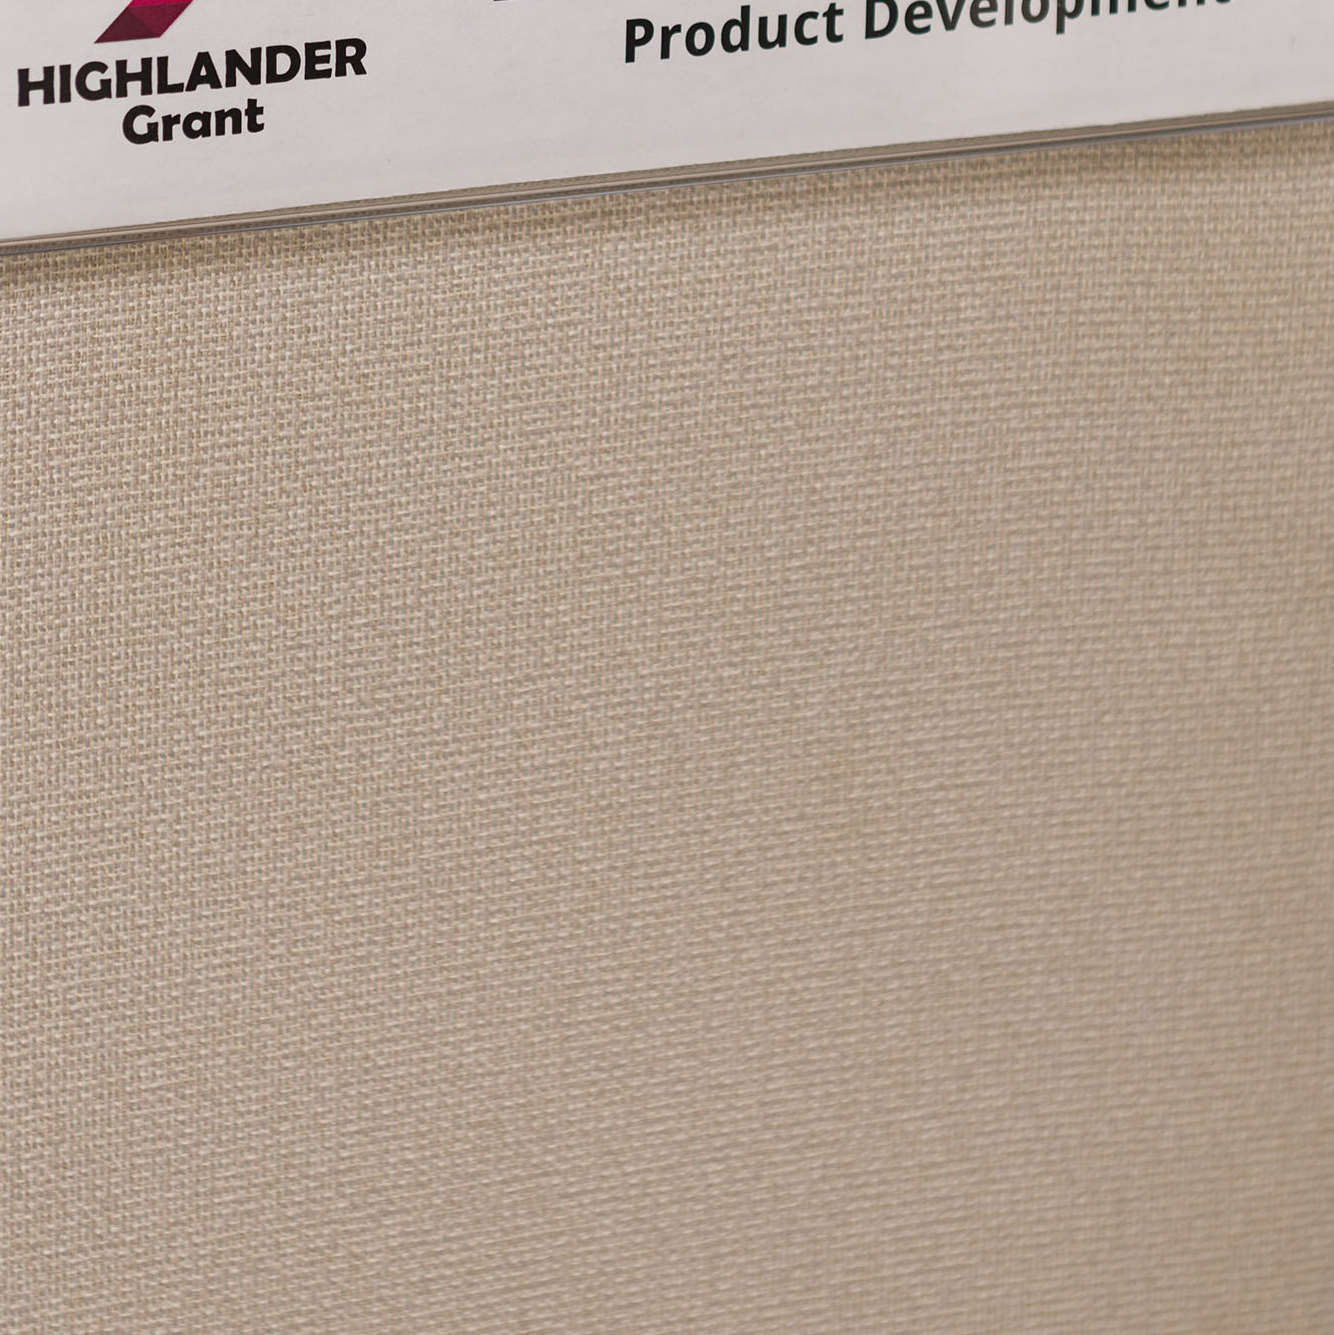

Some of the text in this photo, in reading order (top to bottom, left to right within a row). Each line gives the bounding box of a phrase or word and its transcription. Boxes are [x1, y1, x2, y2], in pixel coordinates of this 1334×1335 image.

[623, 1, 845, 65] Product
[16, 36, 369, 108] HIGHLANDER
[121, 97, 266, 146] Grant
